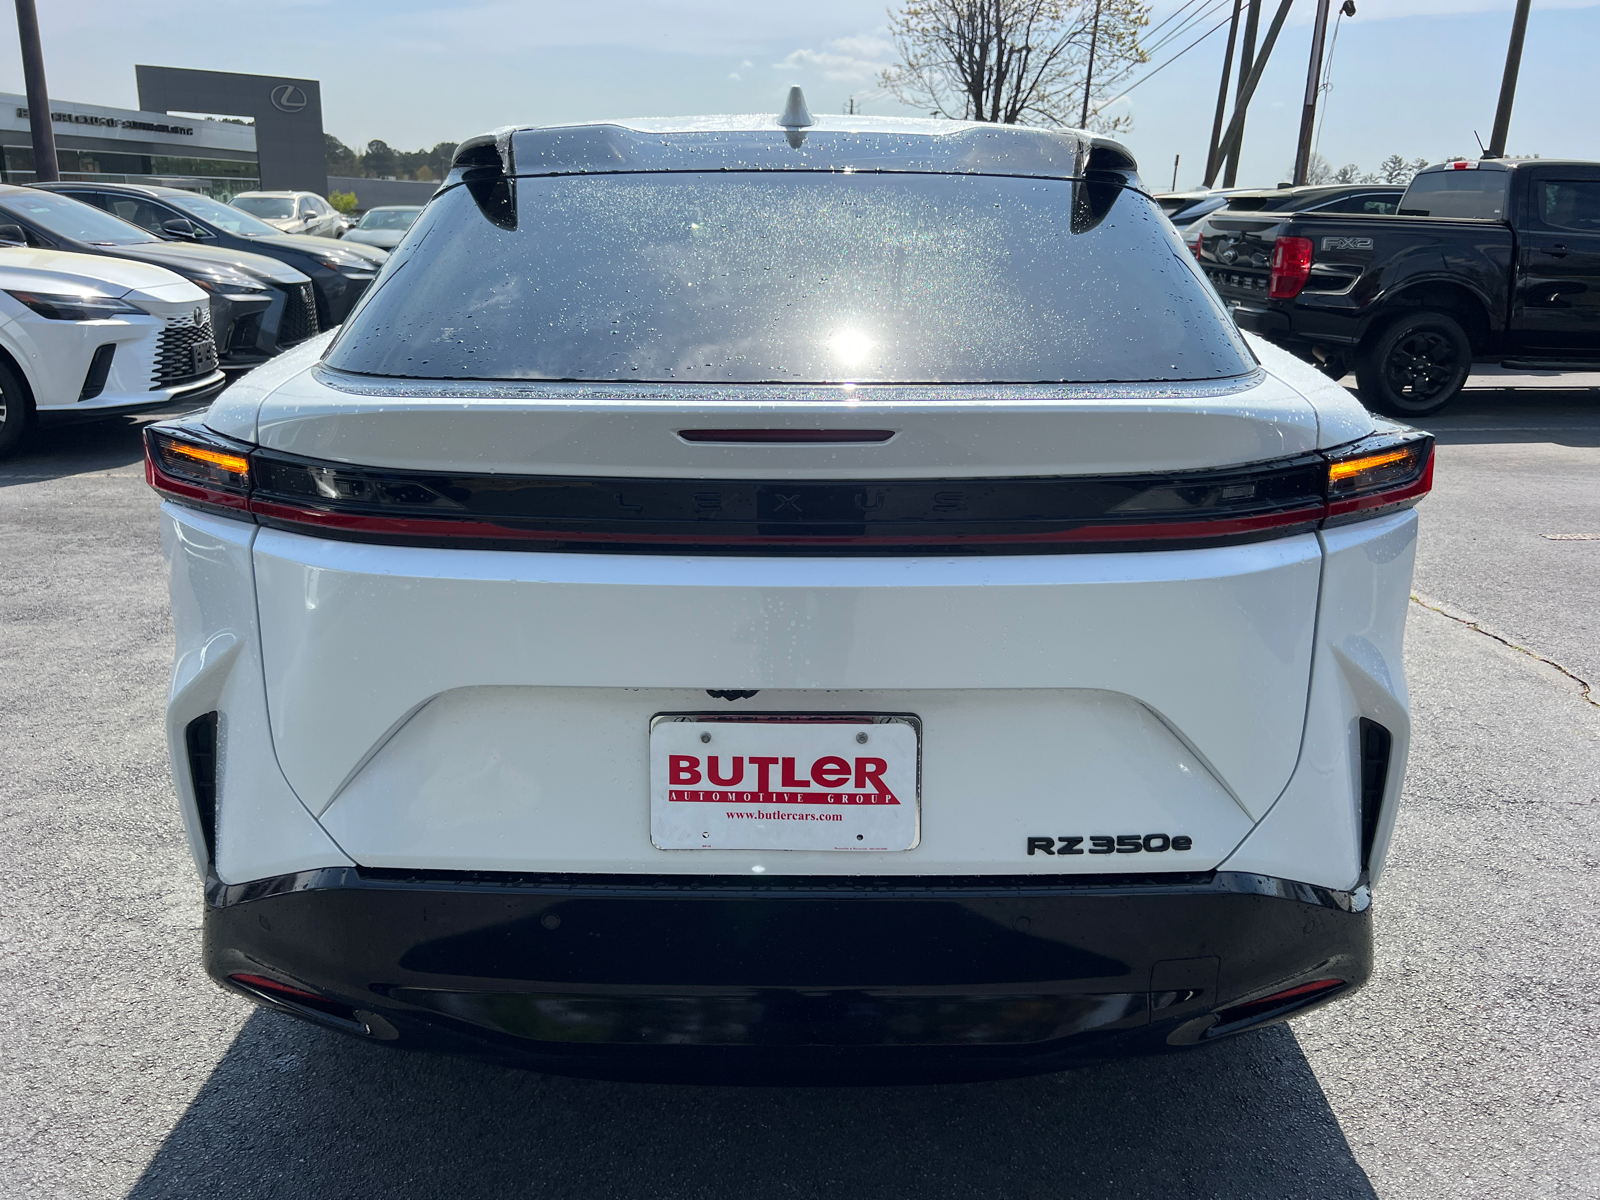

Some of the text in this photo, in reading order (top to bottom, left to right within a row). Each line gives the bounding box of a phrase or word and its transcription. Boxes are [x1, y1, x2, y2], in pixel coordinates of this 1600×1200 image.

[1321, 237, 1374, 250] FX2
[1208, 271, 1268, 292] ANGER
[614, 491, 965, 513] LEXUS
[670, 791, 892, 804] AUTOMOTIVE GROUP
[726, 810, 843, 822] www.butlercars.com
